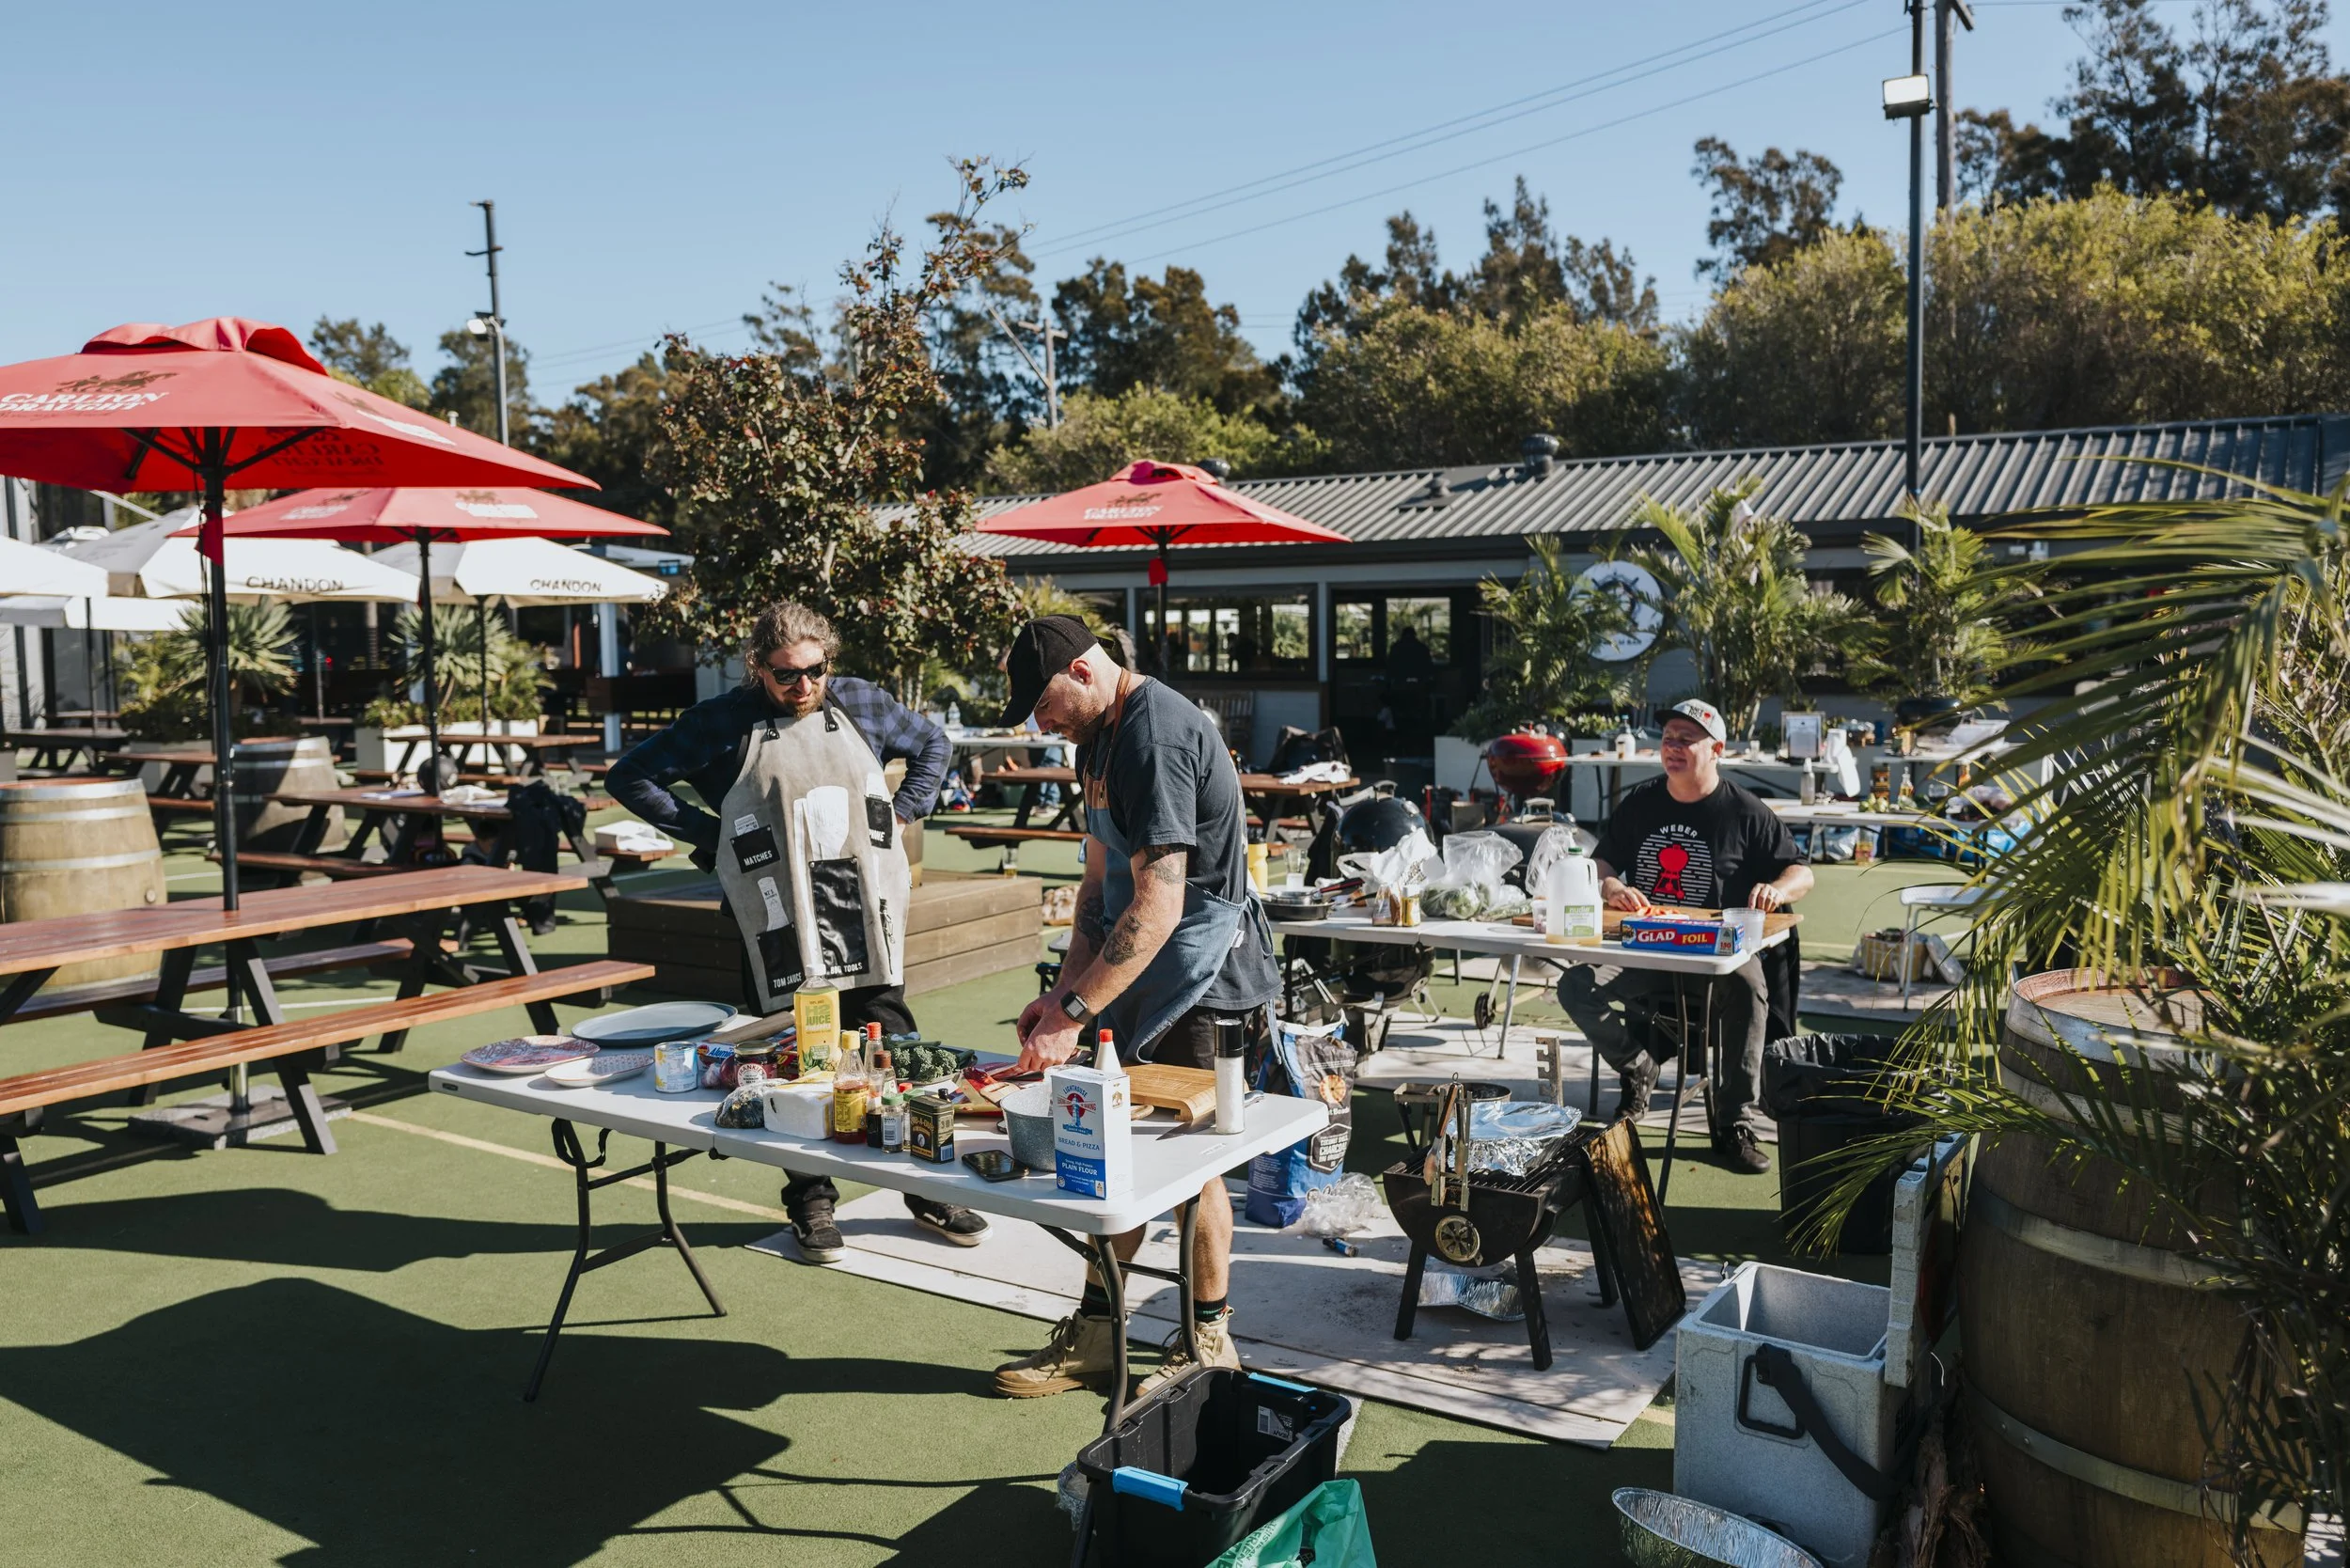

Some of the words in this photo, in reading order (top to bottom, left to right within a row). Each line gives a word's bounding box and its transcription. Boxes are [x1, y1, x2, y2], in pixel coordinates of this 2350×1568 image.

[1, 392, 170, 403] CARLTON
[0, 401, 146, 412] DRAUGHT
[245, 575, 344, 592] CHANDON
[529, 578, 602, 592] CHANDON
[1659, 823, 1699, 839] WEBER
[744, 850, 773, 867] MATCHES
[1637, 930, 1676, 943] GLAD
[1682, 933, 1708, 945] FOIL
[843, 962, 863, 973] TOOLS
[773, 978, 787, 989] TOM
[787, 972, 802, 985] SAUCE
[806, 1014, 831, 1026] JUICE
[1063, 1084, 1088, 1098] LIGHTHOUSE
[1058, 1137, 1075, 1146] BREAD
[1082, 1142, 1100, 1151] PIZZA
[1062, 1162, 1078, 1171] PLAIN
[1078, 1166, 1098, 1176] FLOUR
